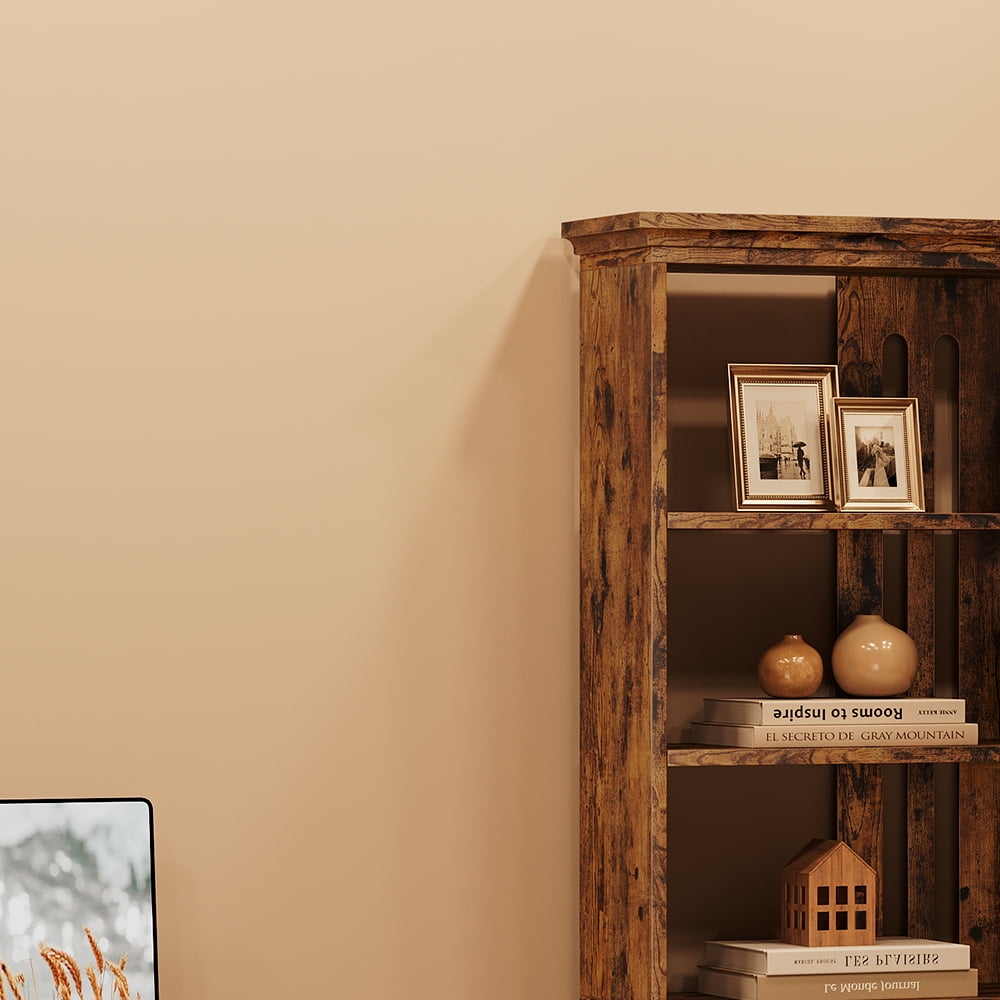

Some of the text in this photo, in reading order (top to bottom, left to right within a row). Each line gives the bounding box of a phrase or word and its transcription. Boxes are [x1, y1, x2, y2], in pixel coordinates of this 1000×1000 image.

[773, 705, 902, 722] Rooms to Inspire
[766, 730, 965, 742] EL SECRETO DE GRAY MOUNTAIN
